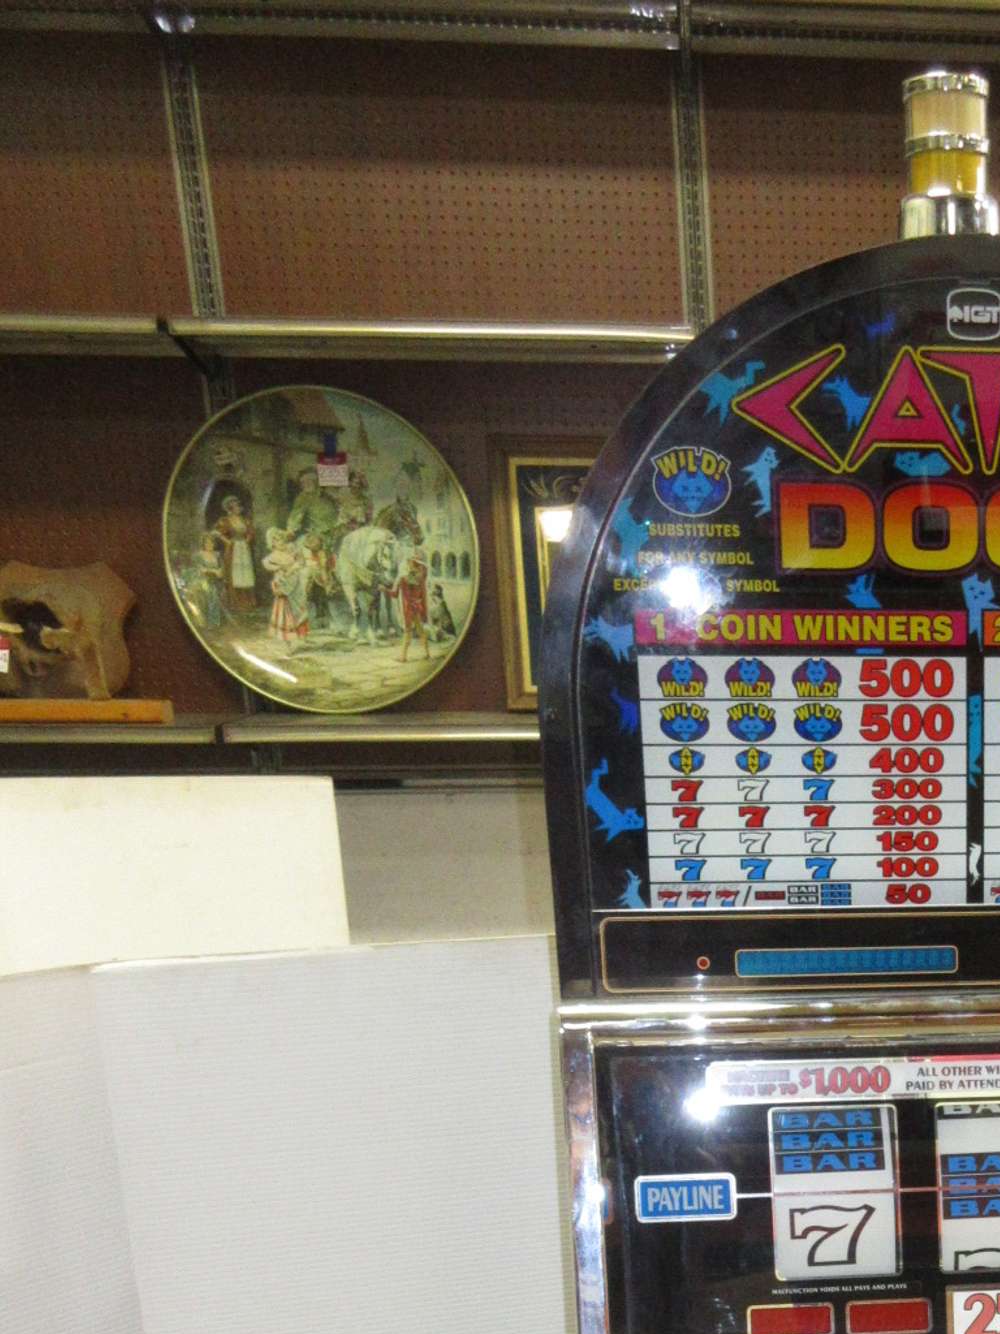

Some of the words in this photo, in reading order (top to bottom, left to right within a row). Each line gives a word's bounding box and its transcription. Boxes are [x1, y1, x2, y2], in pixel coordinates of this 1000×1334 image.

[655, 451, 729, 482] WILD!
[649, 523, 741, 538] SUBSTITUTES
[700, 552, 754, 566] SYMBOL
[726, 579, 781, 593] SYMBOL
[696, 614, 783, 641] COIN
[793, 615, 954, 642] WINNERS
[661, 682, 705, 698] WILD!
[729, 682, 773, 698] WILD!
[796, 682, 840, 698] WILD!
[859, 658, 954, 698] 500
[660, 703, 708, 721] WILD!
[727, 703, 775, 721] WILD!
[794, 703, 842, 721] WILD!
[859, 703, 954, 742] 500
[869, 747, 944, 773] 400
[871, 778, 943, 800] 300
[872, 805, 942, 827] 200
[876, 831, 939, 852] 150
[876, 857, 939, 878] 100
[885, 883, 932, 904] 50
[800, 1065, 892, 1096] $1,000
[917, 1066, 937, 1077] ALL
[939, 1065, 983, 1077] OTHER
[905, 1080, 935, 1091] PAID
[939, 1079, 955, 1090] BY
[781, 1110, 874, 1129] BAR
[781, 1131, 876, 1150] BAR
[782, 1151, 878, 1172] BAR
[647, 1184, 725, 1213] PAYLINE
[788, 1204, 876, 1268] 7
